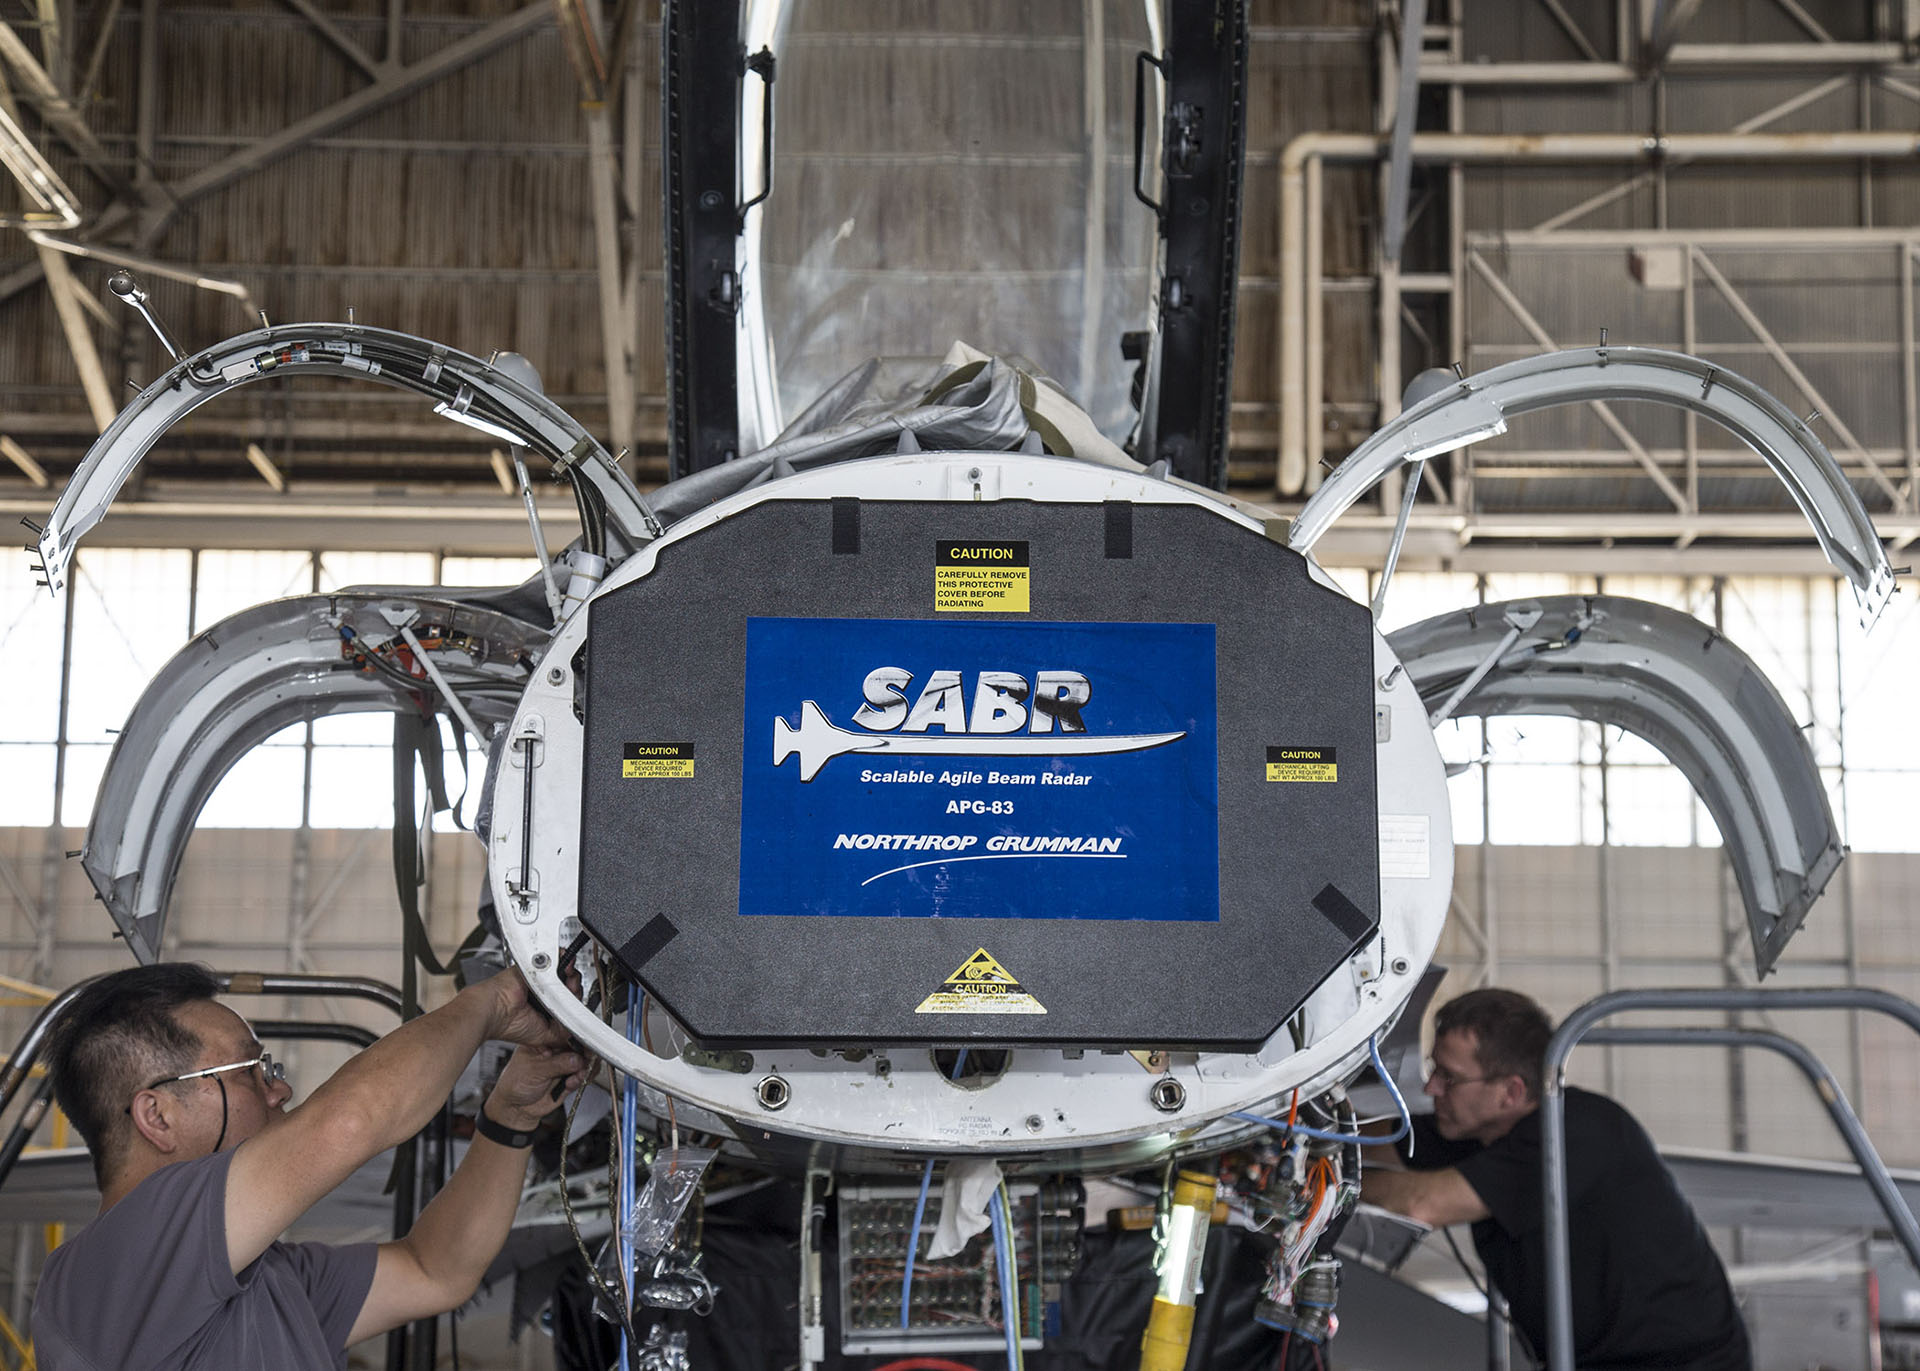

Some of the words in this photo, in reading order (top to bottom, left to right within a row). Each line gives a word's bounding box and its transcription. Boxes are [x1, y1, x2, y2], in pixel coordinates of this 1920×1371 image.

[950, 547, 1013, 560] CAUTION
[937, 571, 988, 579] CAREFULLY
[990, 571, 1027, 579] REMOVE
[938, 580, 957, 588] THIS
[959, 581, 1013, 589] PROTECTIVE
[937, 590, 968, 598] COVER
[970, 590, 1006, 598] BEFORE
[937, 599, 984, 607] RADIATING
[852, 666, 1093, 735] SABR
[638, 747, 679, 755] CAUTION
[1281, 751, 1321, 759] CAUTION
[860, 770, 935, 784] Scalable
[938, 771, 983, 787] Agile
[987, 771, 1036, 785] Beam
[1041, 772, 1093, 786] Radar
[945, 800, 1015, 815] APG-83
[833, 834, 978, 851] NORTHROP
[986, 836, 1122, 853] GRUMMAN
[955, 984, 1007, 993] CAUTION
